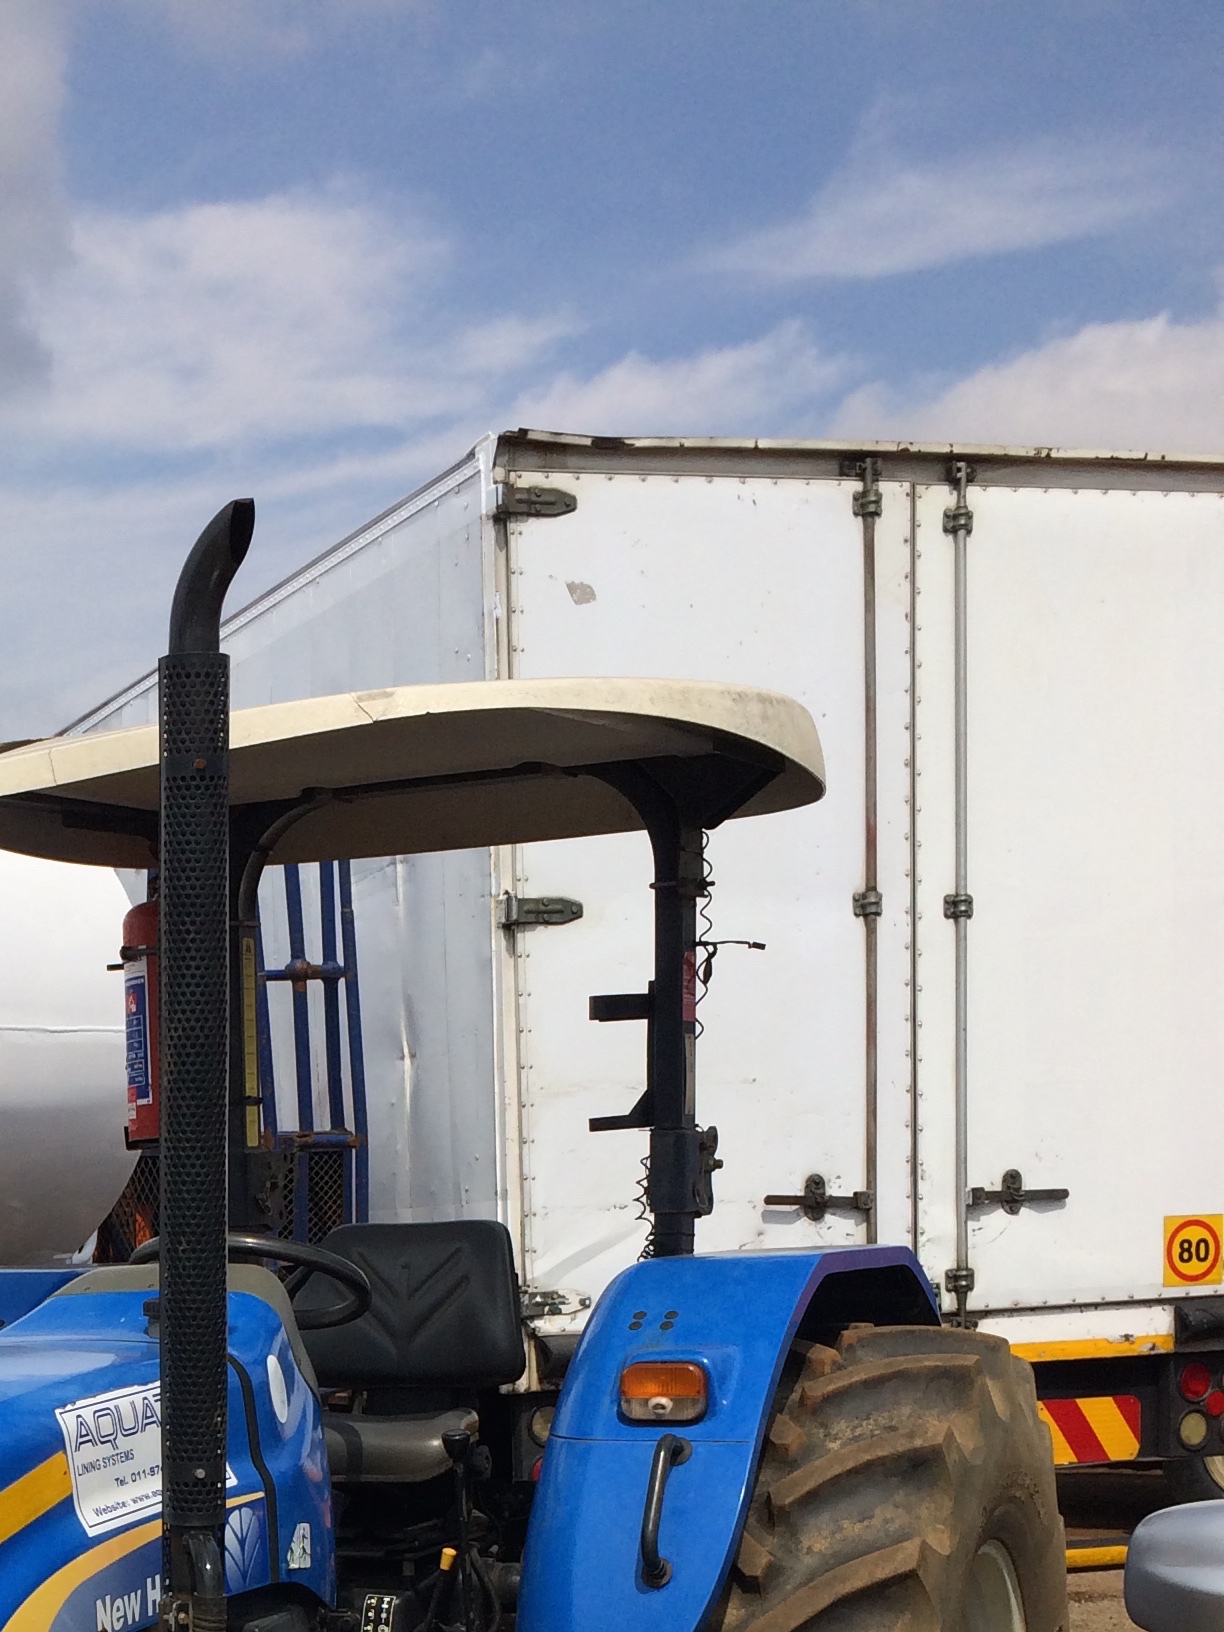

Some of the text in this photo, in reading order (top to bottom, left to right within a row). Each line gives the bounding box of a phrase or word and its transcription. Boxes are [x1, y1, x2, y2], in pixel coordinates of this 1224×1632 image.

[1178, 1237, 1210, 1264] 80
[76, 1448, 135, 1477] LINING SYSTEMS
[130, 1464, 162, 1483] 011-97
[146, 1574, 161, 1617] H
